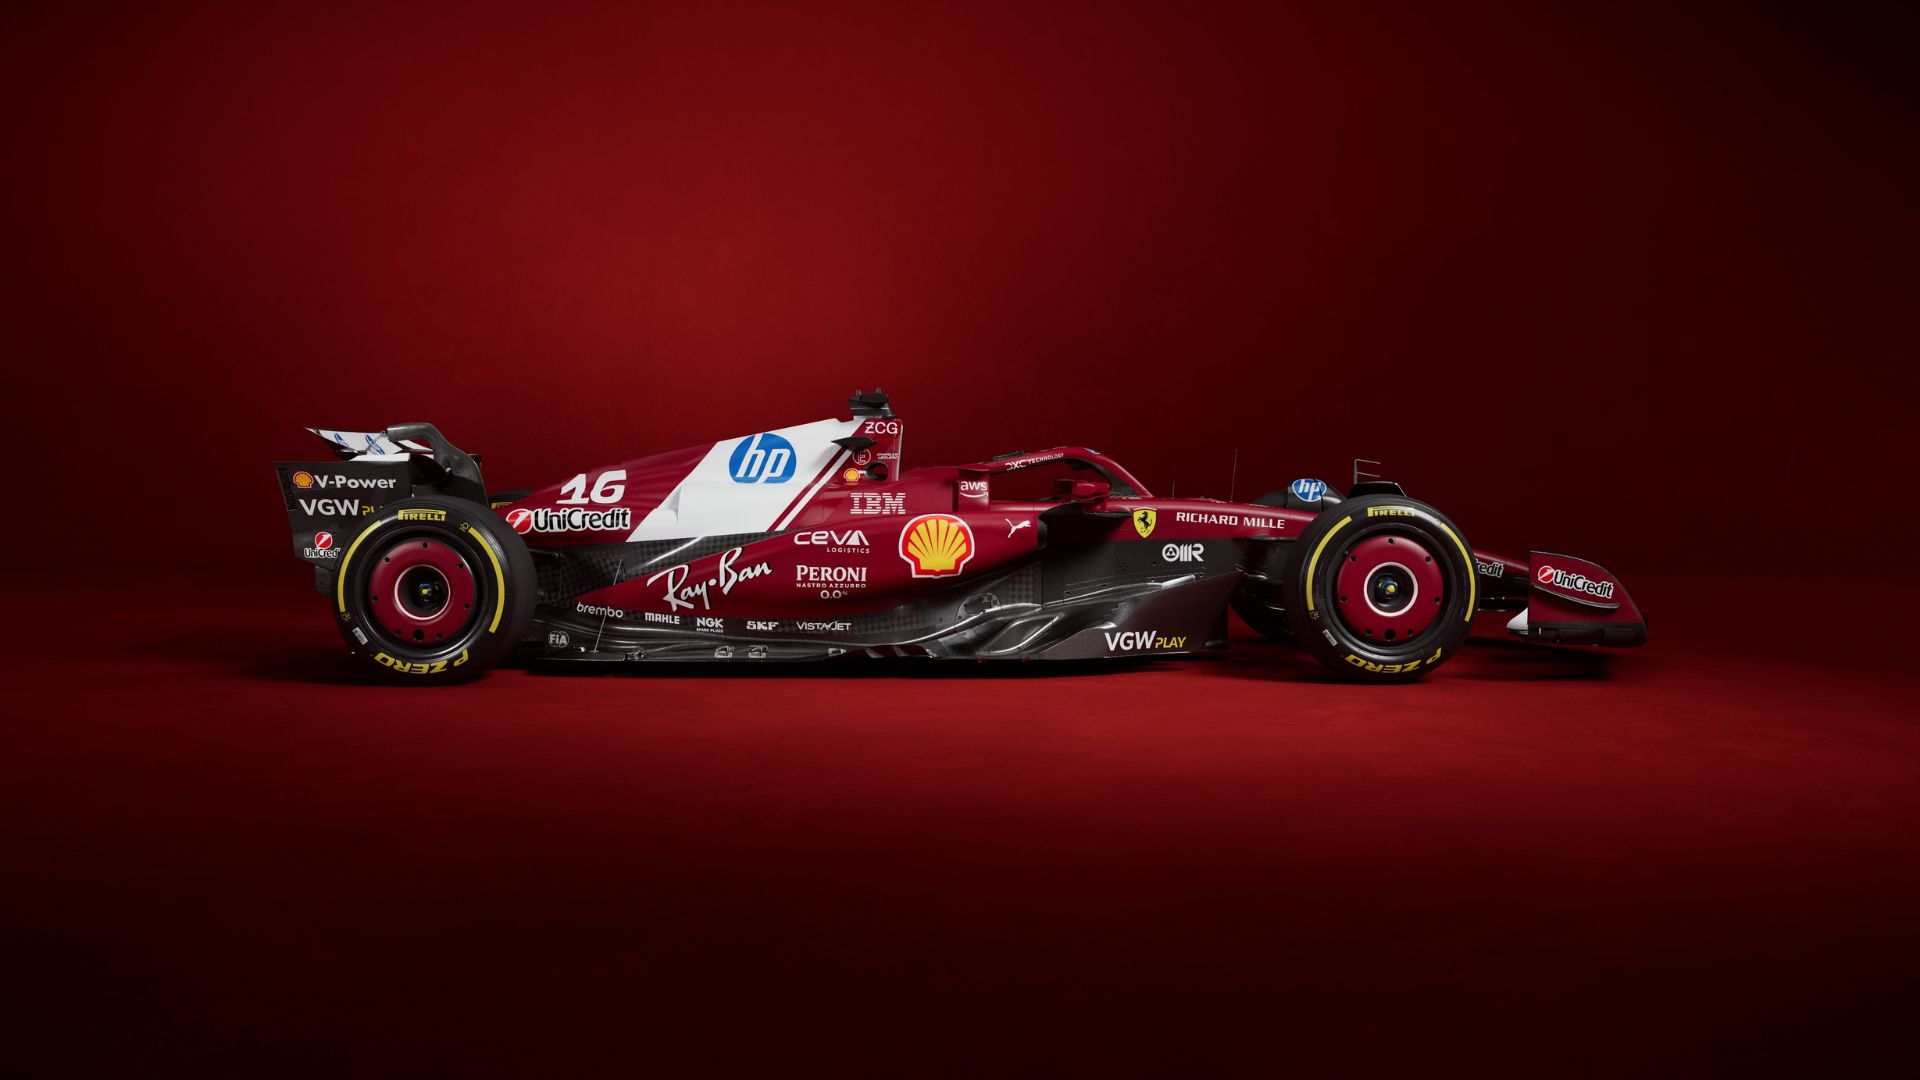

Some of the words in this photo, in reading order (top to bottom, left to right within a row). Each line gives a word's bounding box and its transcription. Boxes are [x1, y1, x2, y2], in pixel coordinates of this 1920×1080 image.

[735, 433, 791, 484] hp
[1028, 453, 1064, 464] TECHNOLOGY
[314, 475, 396, 488] V-Power
[556, 469, 627, 504] 16
[960, 480, 988, 491] aws
[299, 499, 359, 516] VGW
[850, 492, 906, 515] IBM
[1367, 505, 1416, 517] PIRELLI
[398, 508, 447, 521] PIRELLI
[533, 508, 630, 532] UniCredit
[1176, 511, 1238, 526] RICHARD
[1243, 517, 1286, 529] MILLE
[796, 564, 868, 582] PERONI
[1553, 569, 1614, 599] UniCredit
[576, 602, 624, 618] brembo
[645, 612, 681, 625] MAHLE
[696, 617, 724, 628] NGK
[746, 620, 779, 630] SKF
[1104, 630, 1157, 651] VGW
[1155, 636, 1187, 648] PLAY
[374, 652, 448, 674] ZERO
[1345, 654, 1421, 673] ZERO
